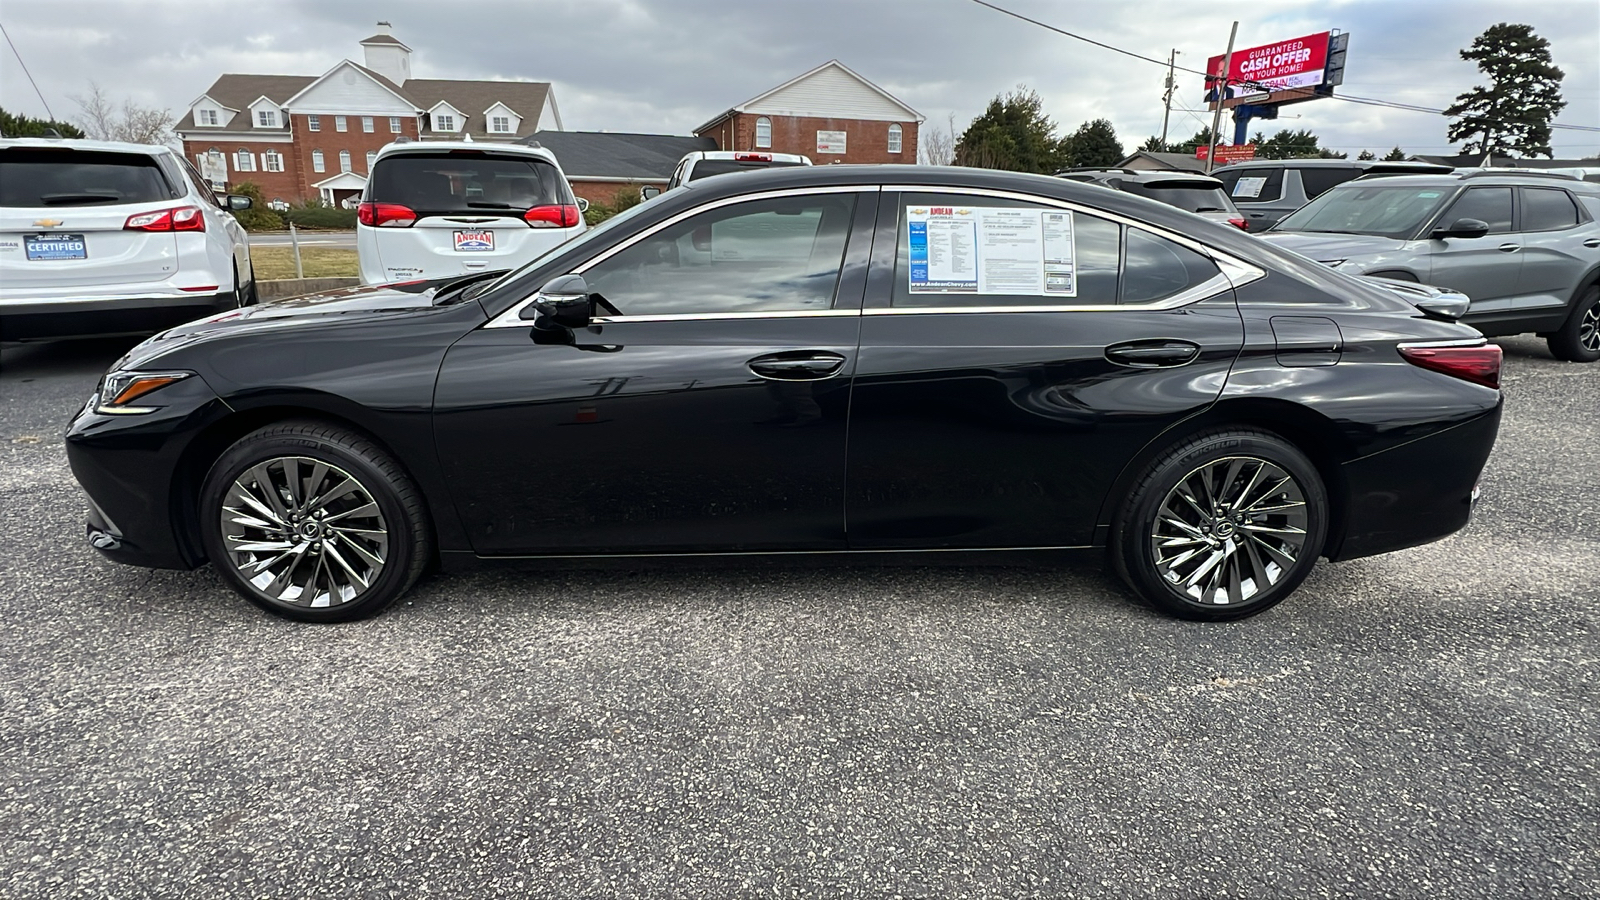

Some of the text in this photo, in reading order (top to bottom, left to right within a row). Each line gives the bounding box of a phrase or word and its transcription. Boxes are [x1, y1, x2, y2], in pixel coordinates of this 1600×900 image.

[1249, 41, 1303, 59] GUARANTEED
[1240, 48, 1311, 73] CASH OFFER
[1243, 63, 1303, 81] ON YOUR HOME!
[930, 207, 953, 216] ANDEAN
[28, 242, 84, 252] CERTIFIED
[457, 234, 492, 245] ANDEAN
[1190, 440, 1238, 458] MICHELIN
